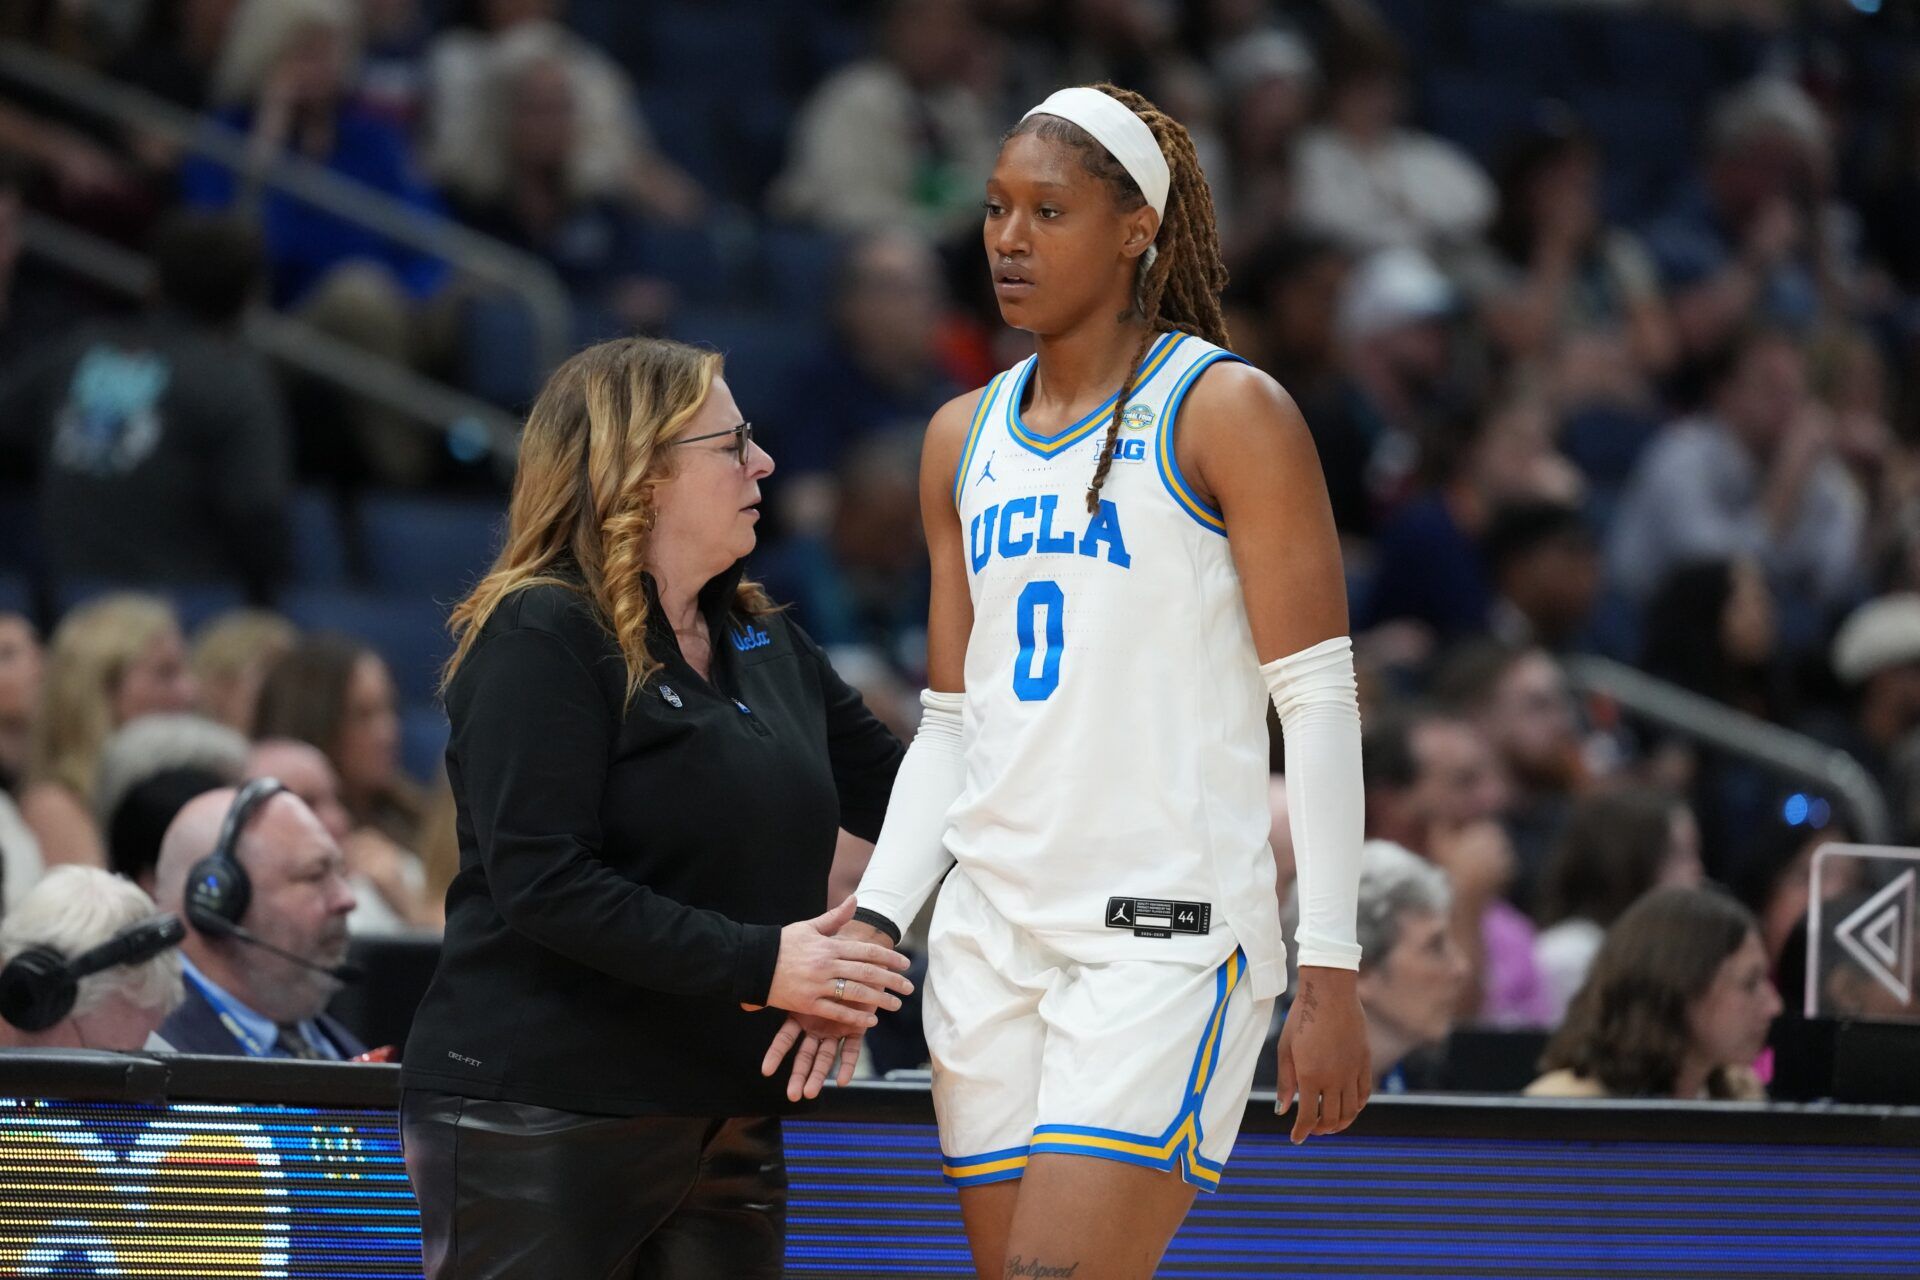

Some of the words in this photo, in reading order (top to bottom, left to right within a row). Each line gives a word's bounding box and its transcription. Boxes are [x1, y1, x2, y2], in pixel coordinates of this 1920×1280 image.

[970, 494, 1131, 575] UCLA
[1013, 581, 1064, 701] 0
[1178, 910, 1195, 924] 44
[448, 1051, 482, 1067] DRI-FIT
